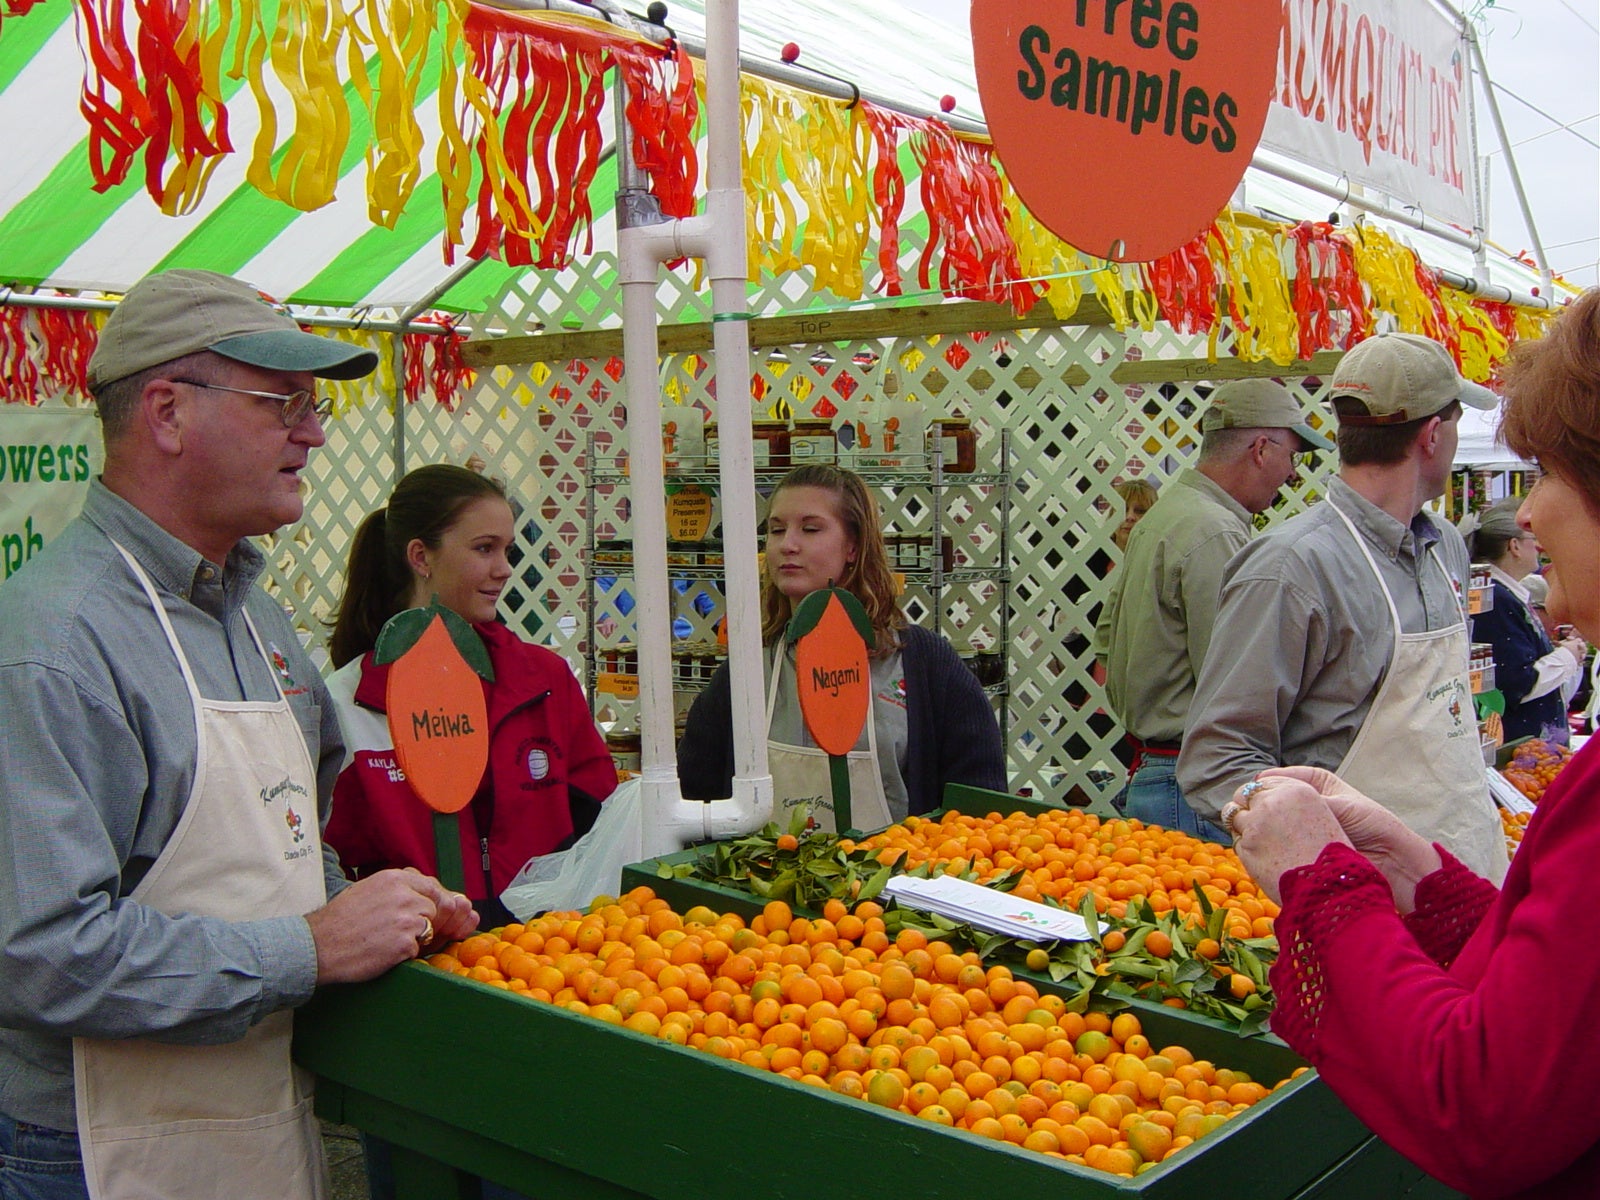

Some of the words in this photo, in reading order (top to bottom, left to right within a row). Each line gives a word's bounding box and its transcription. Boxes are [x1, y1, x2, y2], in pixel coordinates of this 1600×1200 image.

[1017, 24, 1238, 153] Samples
[1428, 66, 1464, 196] PIE
[794, 320, 832, 335] TOP
[811, 661, 861, 698] Nagami
[411, 707, 476, 742] Meiwa
[367, 757, 397, 769] KAYLA
